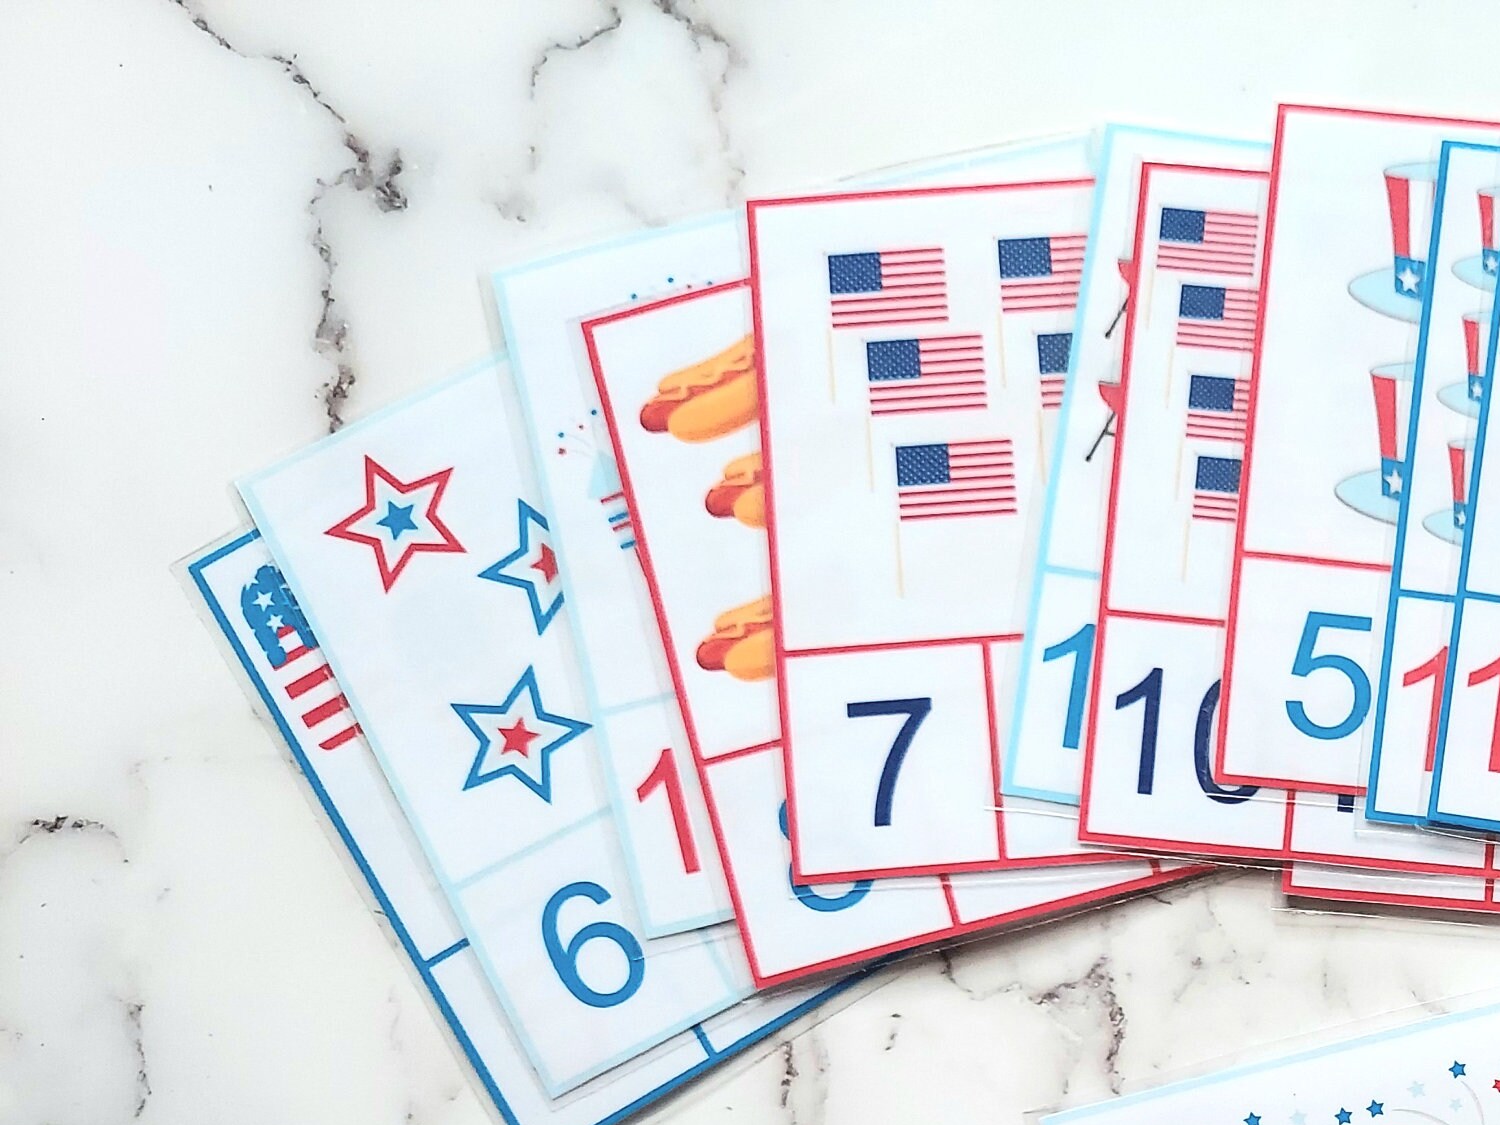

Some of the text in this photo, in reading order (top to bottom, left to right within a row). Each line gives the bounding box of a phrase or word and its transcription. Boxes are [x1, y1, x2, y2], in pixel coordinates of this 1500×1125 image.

[1285, 611, 1373, 740] 5
[847, 697, 932, 827] 7
[542, 881, 645, 1008] 6
